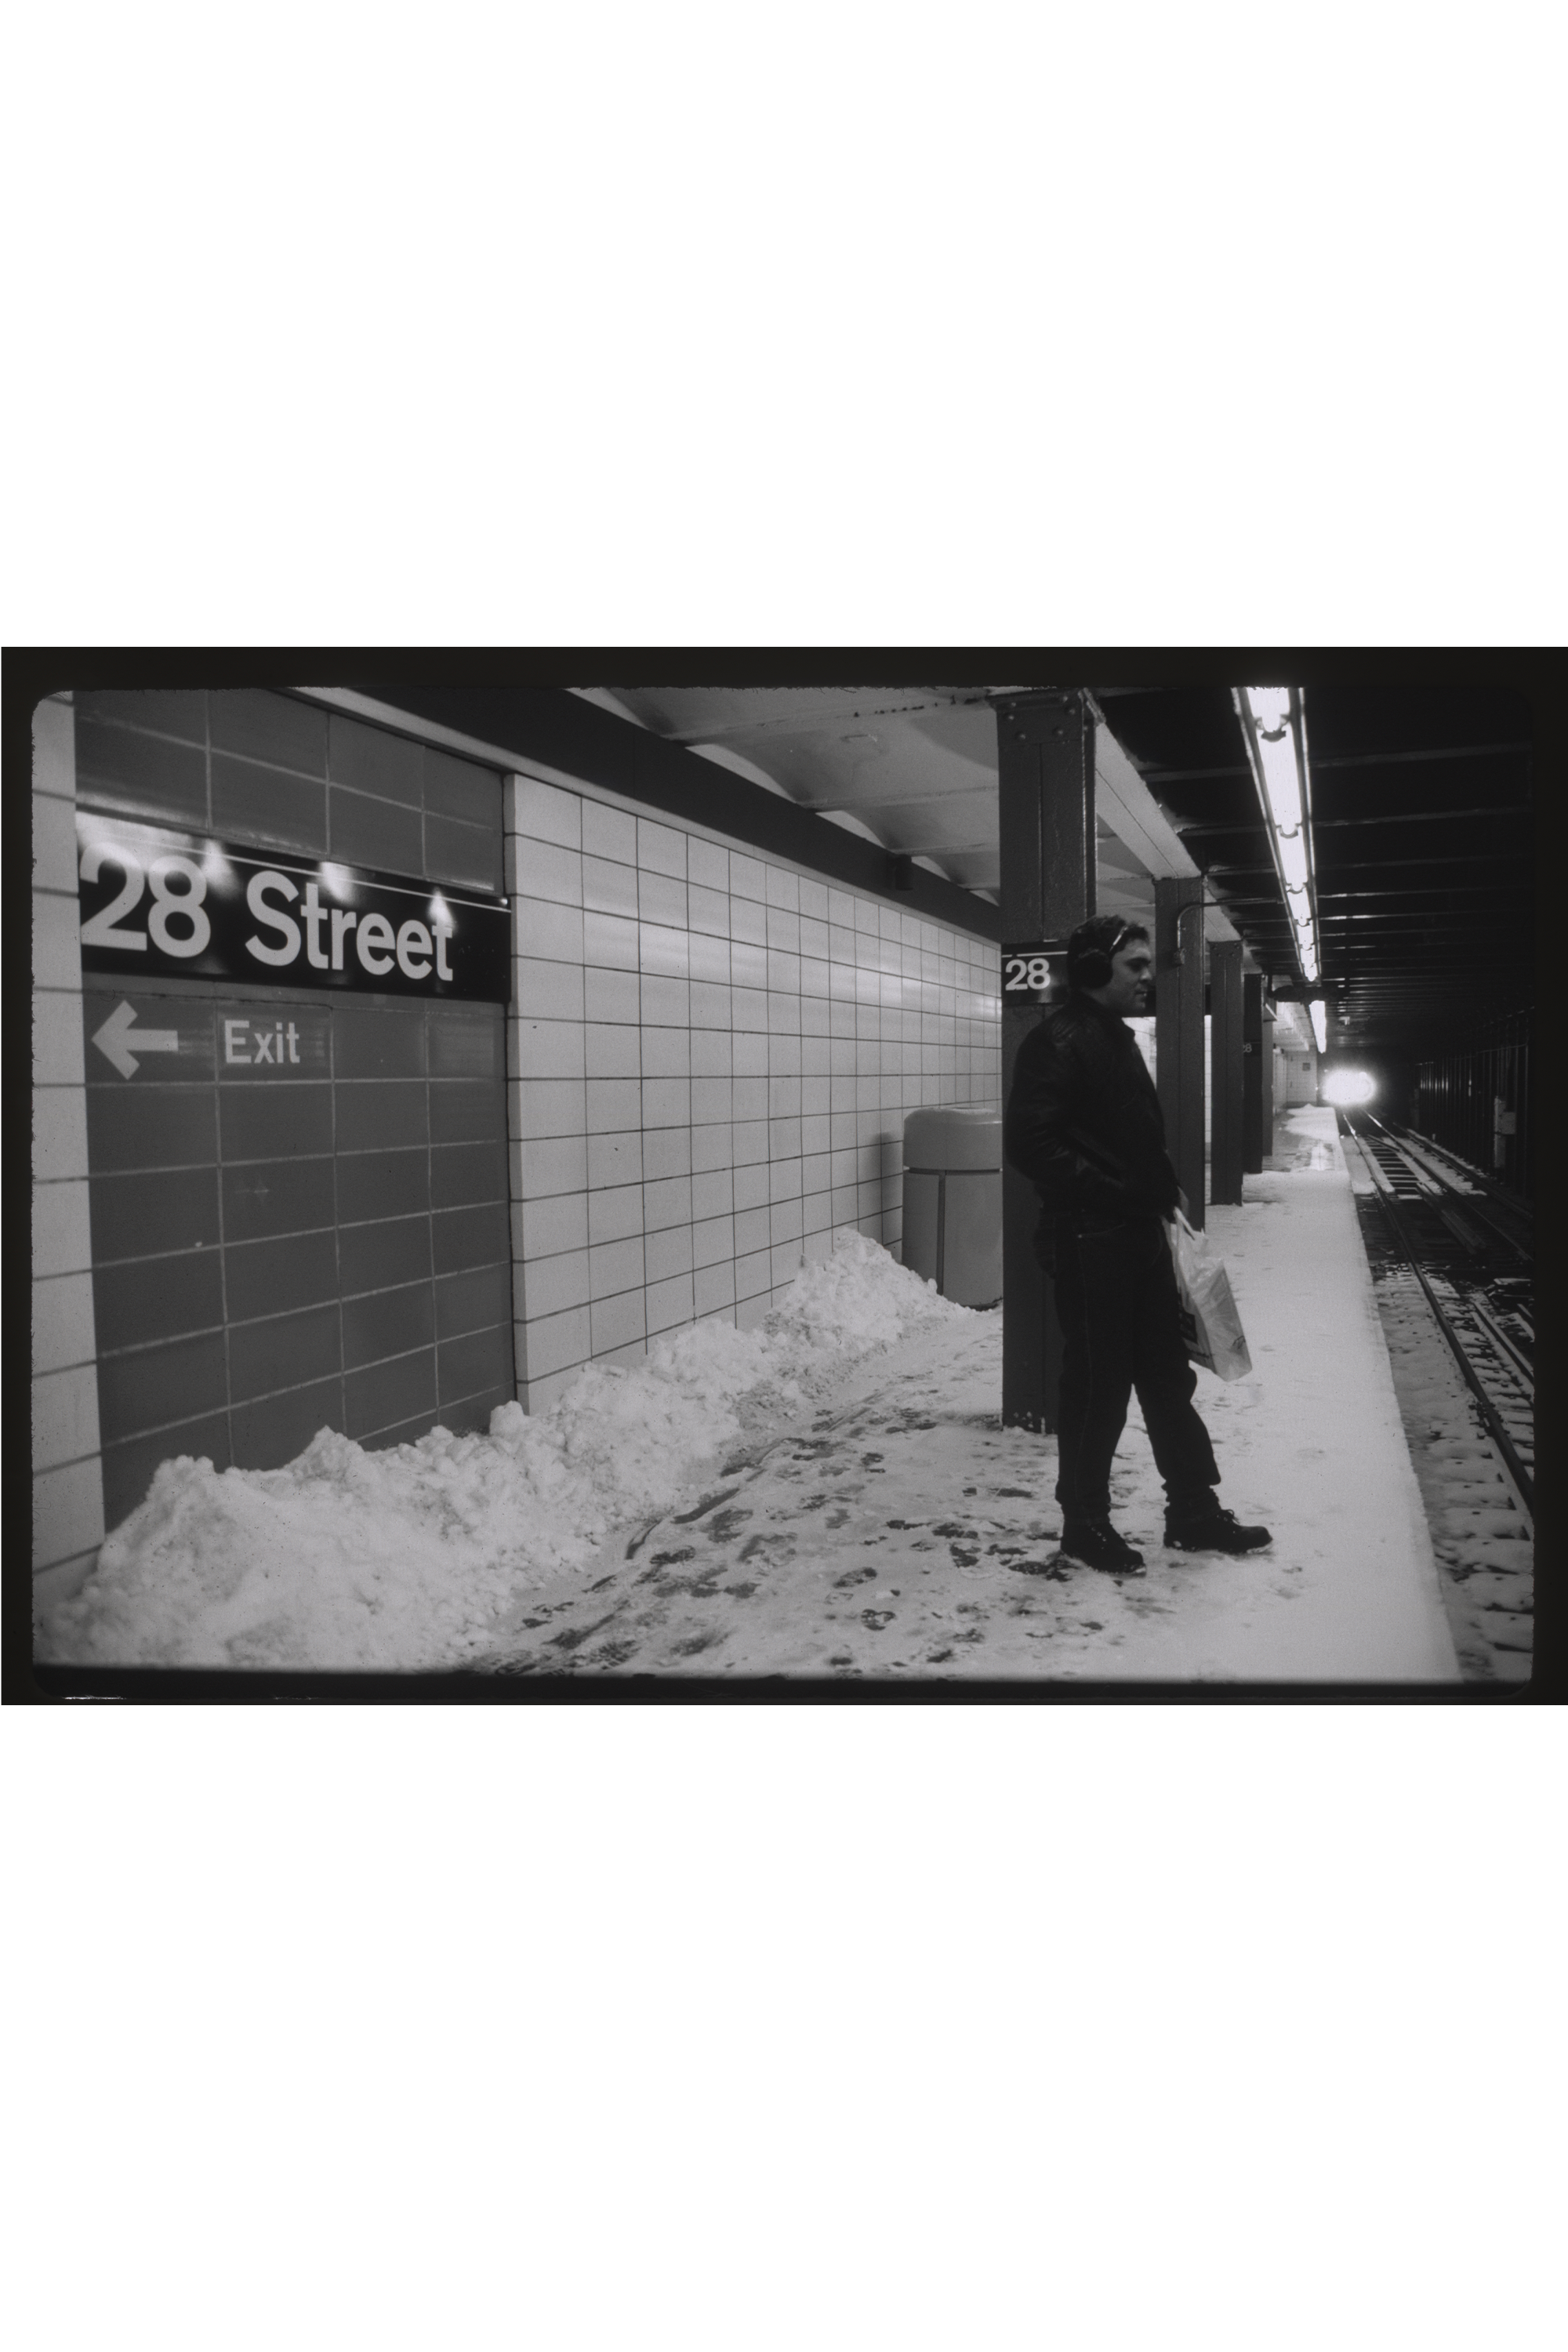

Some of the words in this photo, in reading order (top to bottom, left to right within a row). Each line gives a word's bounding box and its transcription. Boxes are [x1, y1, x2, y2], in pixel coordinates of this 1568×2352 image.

[79, 841, 211, 958] 28
[245, 870, 453, 982] Street
[1005, 957, 1051, 991] 28
[224, 1019, 300, 1064] Exit
